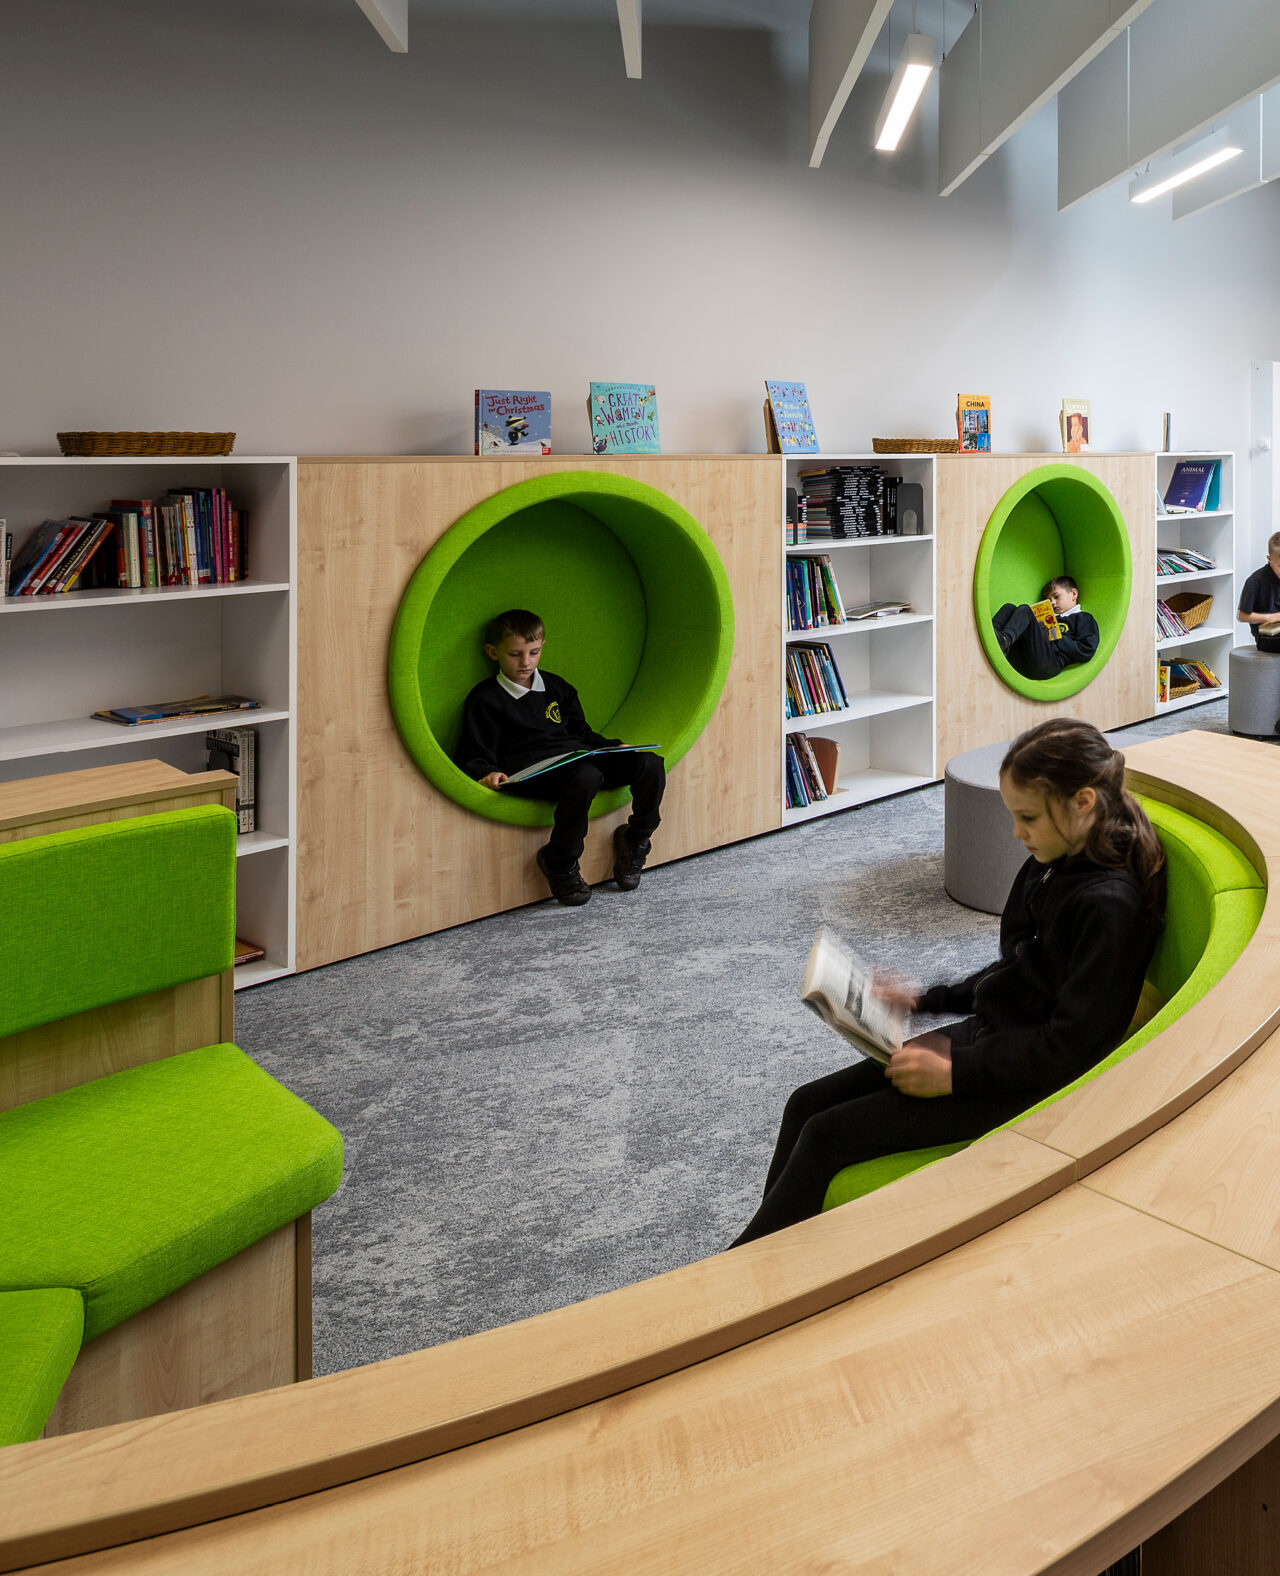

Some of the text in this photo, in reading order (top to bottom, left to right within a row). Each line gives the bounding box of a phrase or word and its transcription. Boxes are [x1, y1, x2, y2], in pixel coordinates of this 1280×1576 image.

[486, 395, 537, 407] Just Right
[608, 392, 640, 407] GREAT
[496, 404, 545, 415] Christmas
[600, 406, 645, 426] WOMEN
[609, 423, 656, 447] HISTORY
